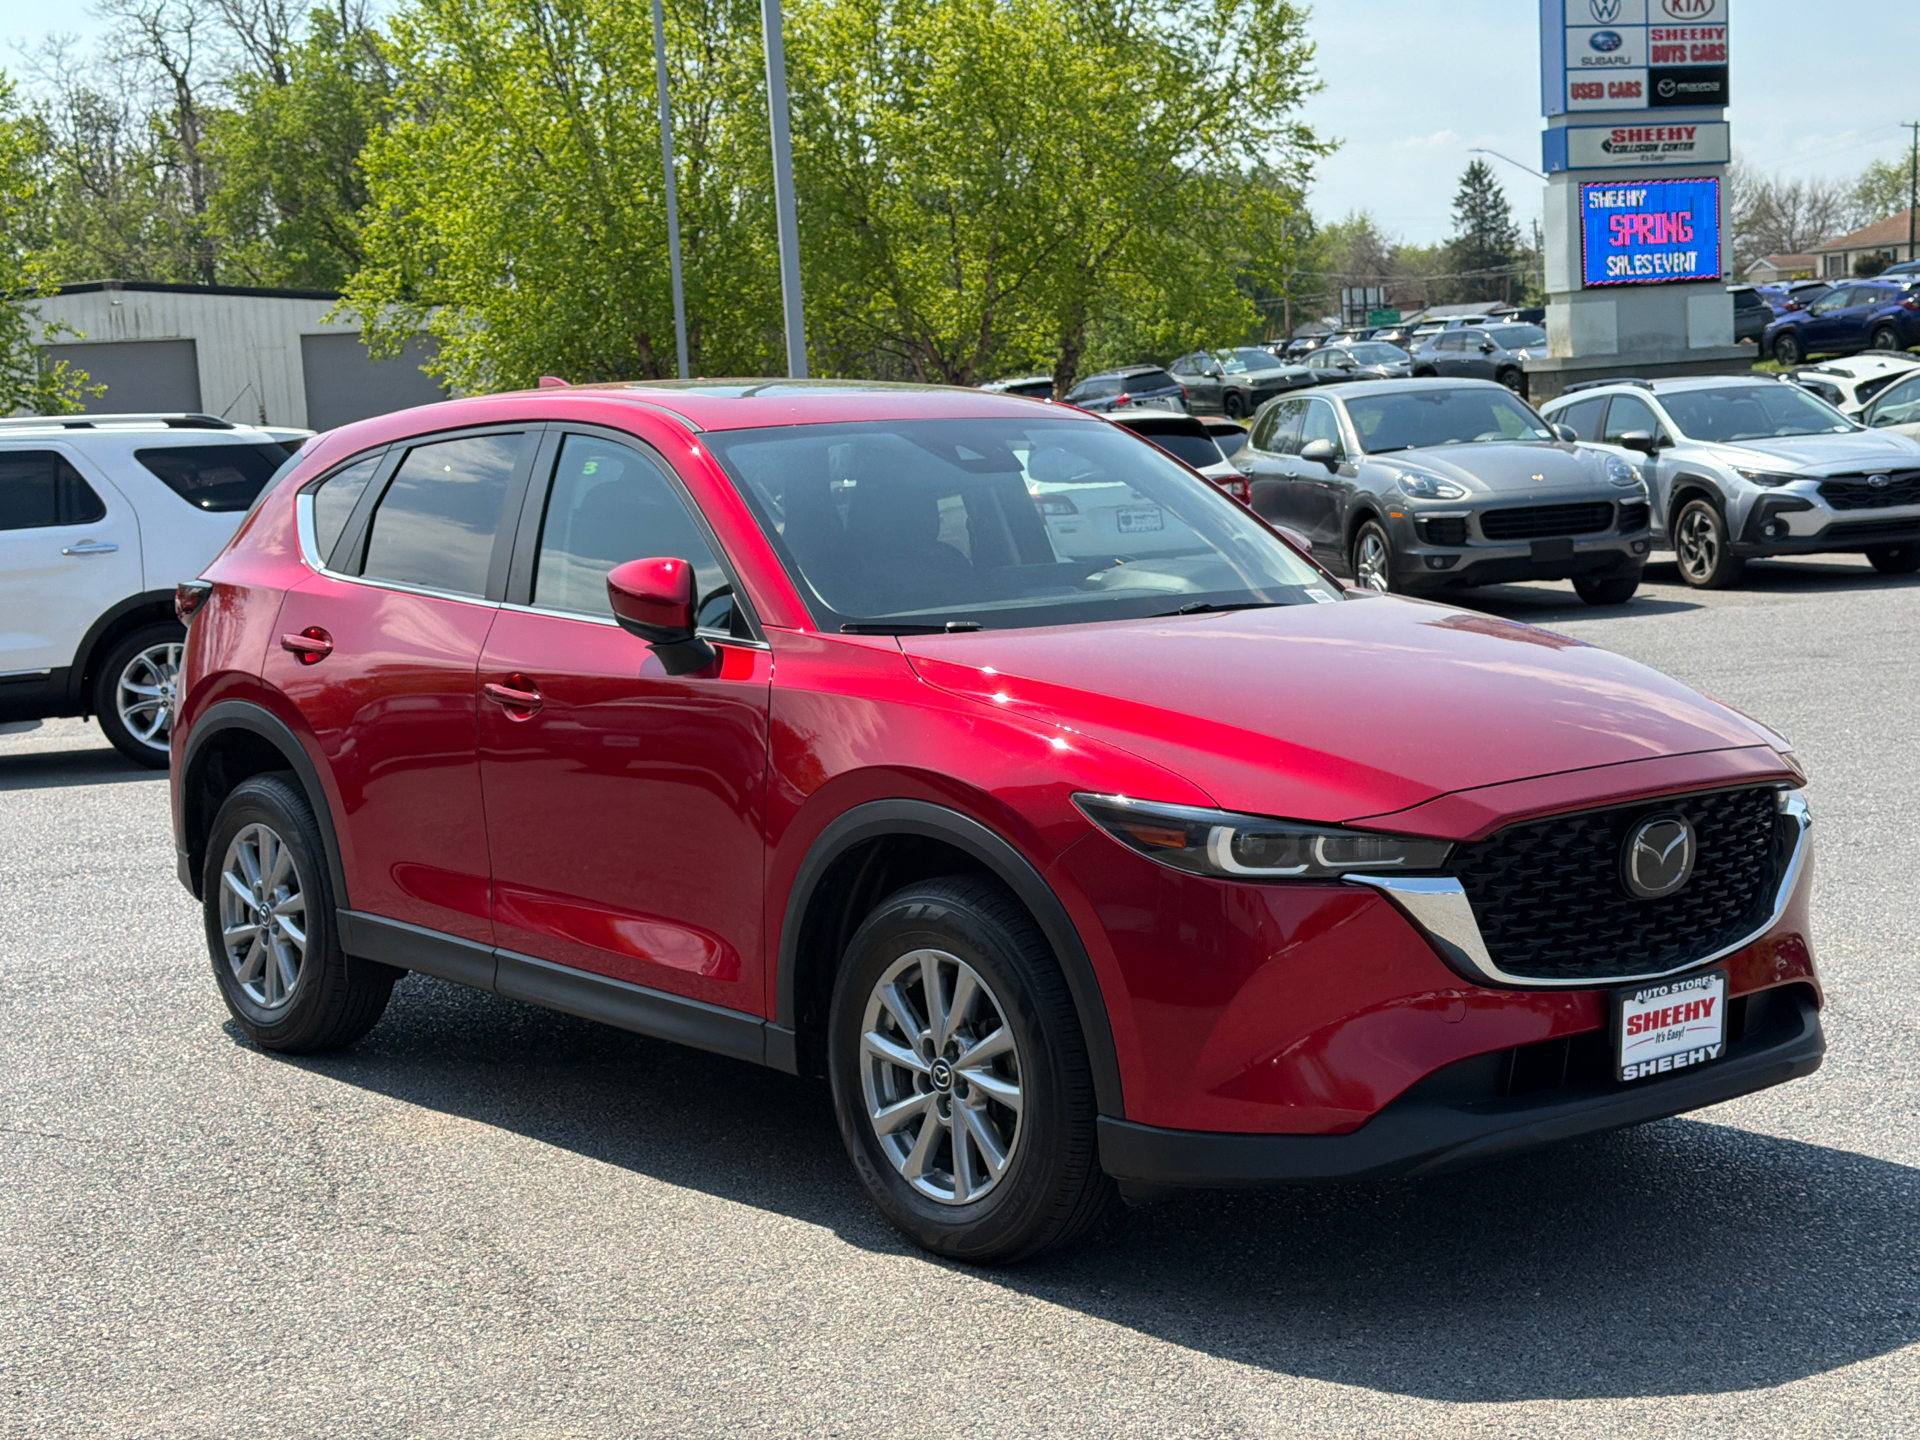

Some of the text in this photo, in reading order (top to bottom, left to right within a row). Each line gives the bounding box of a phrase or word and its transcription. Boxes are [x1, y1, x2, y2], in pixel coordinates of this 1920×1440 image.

[1651, 28, 1725, 41] SHEEHY
[1581, 56, 1631, 66] SUBARU
[1652, 43, 1726, 63] BUYS CARS
[1571, 81, 1642, 100] USED CARS
[1611, 127, 1696, 143] SHEEHY
[1589, 189, 1647, 208] SHEEHY
[1609, 211, 1694, 246] SPRING
[1606, 251, 1698, 276] SALES EVENT
[1635, 974, 1716, 1001] AUTO STORES
[1627, 997, 1716, 1036] SHEEHY
[1655, 1026, 1685, 1043] It's Easy!
[1623, 1044, 1722, 1081] SHEEHY
